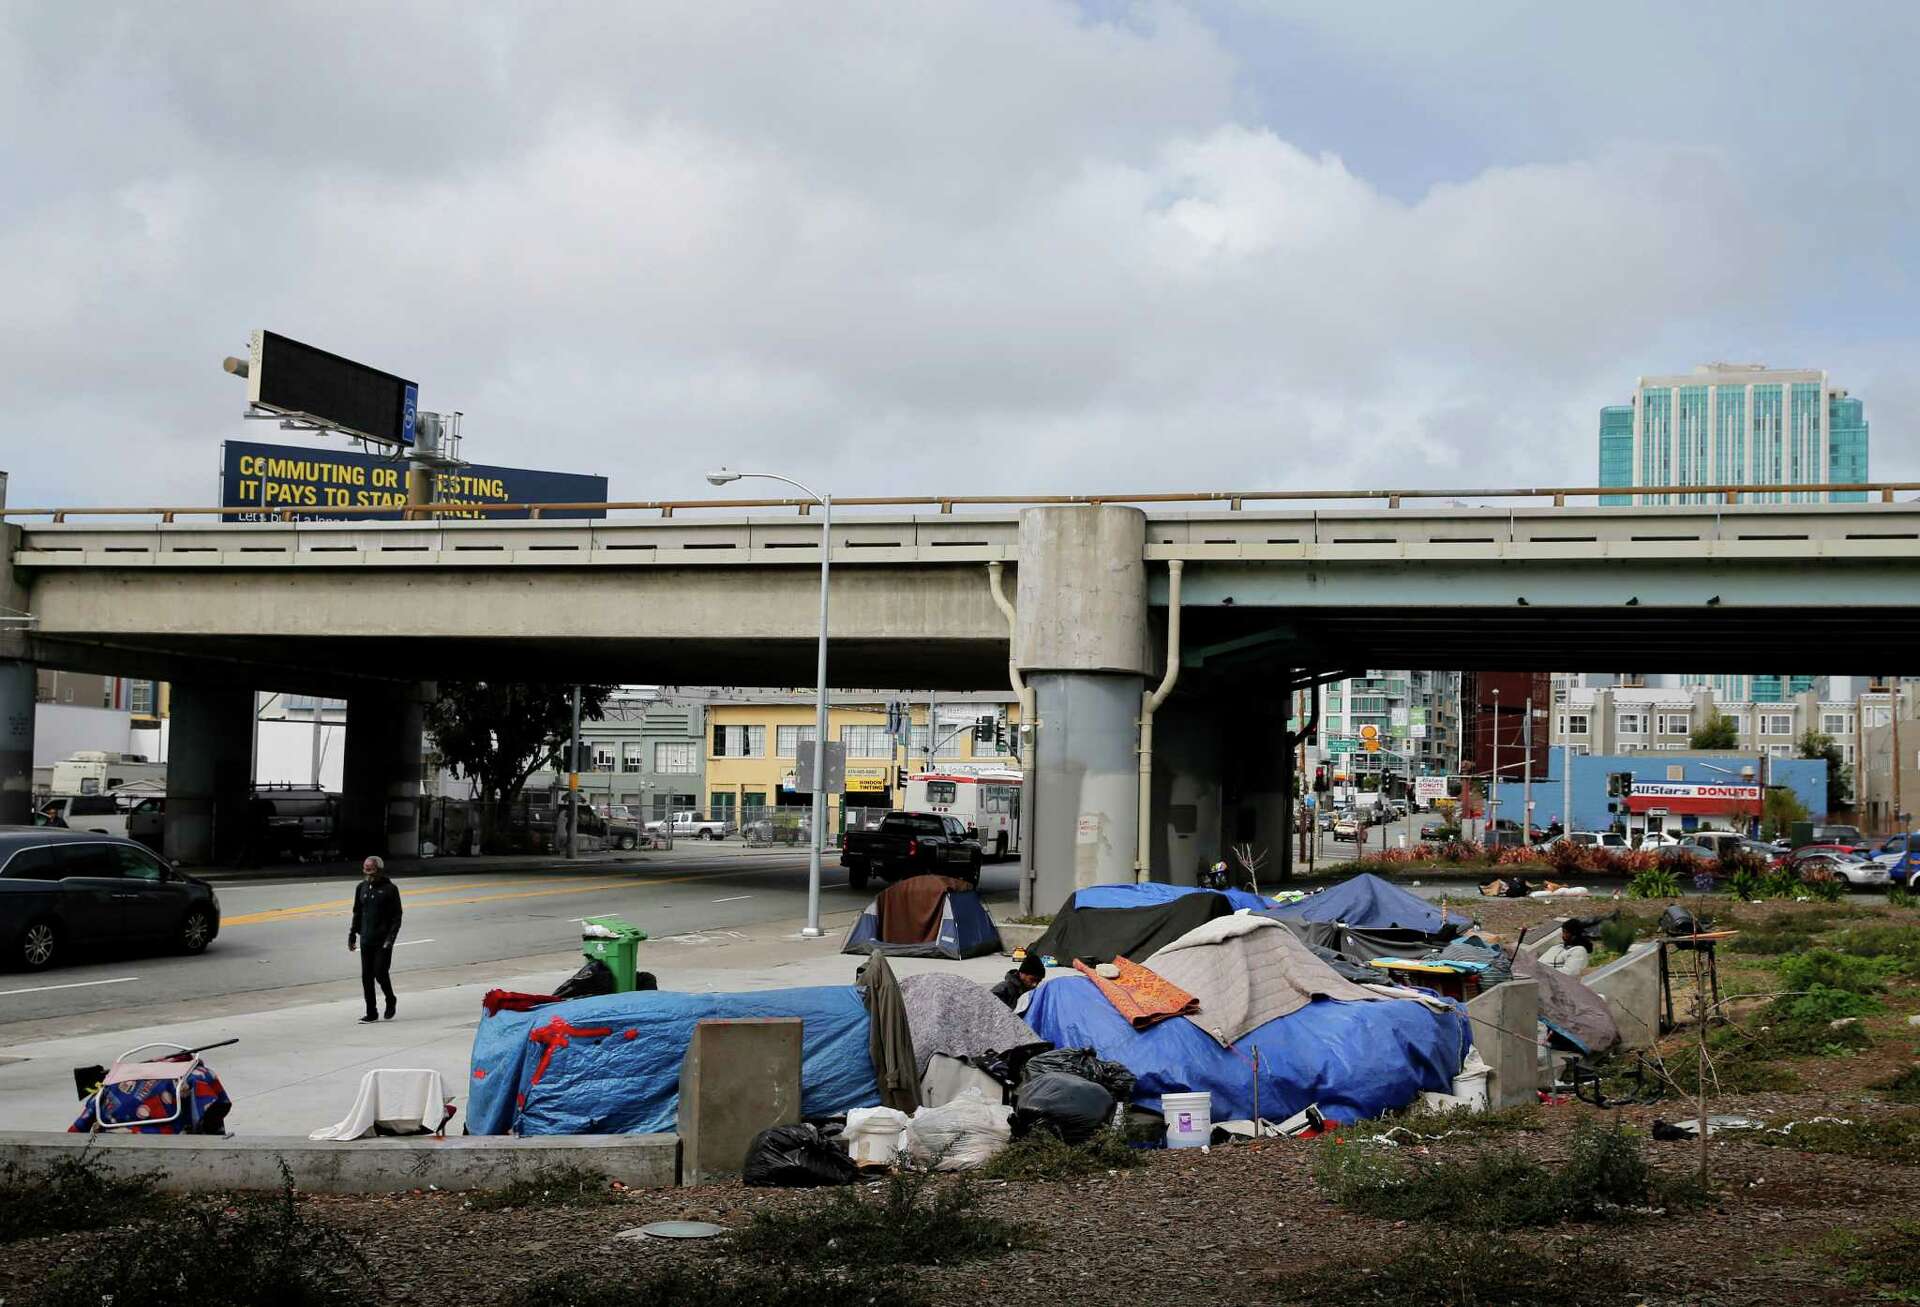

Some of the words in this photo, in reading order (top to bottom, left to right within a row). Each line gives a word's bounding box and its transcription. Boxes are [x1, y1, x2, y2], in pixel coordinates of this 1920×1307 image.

[239, 455, 365, 486] COMMUTING
[371, 468, 398, 488] OR
[405, 470, 509, 501] IESTING,
[239, 480, 259, 500] IT
[265, 481, 317, 505] PAYS
[324, 487, 350, 507] TO
[356, 490, 408, 509] STAR
[1632, 785, 1691, 795] AllStars
[1697, 786, 1757, 797] DONUTS
